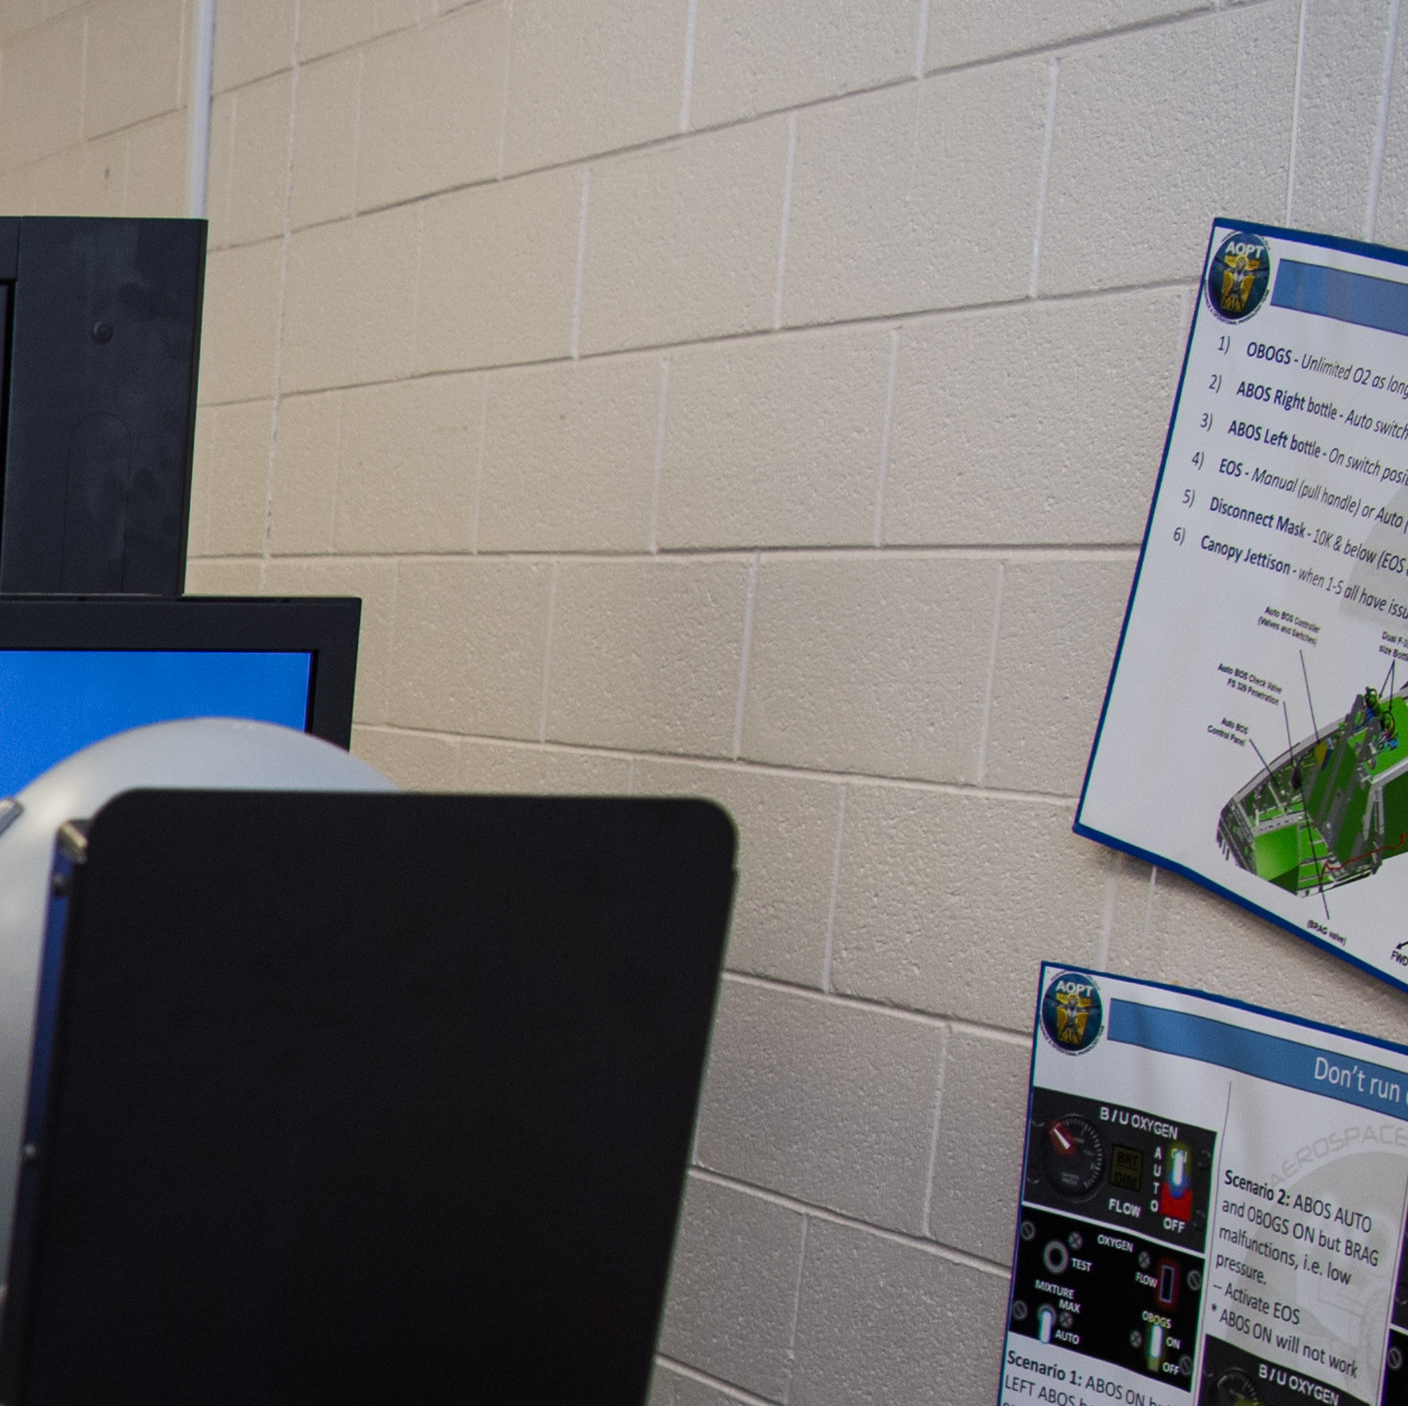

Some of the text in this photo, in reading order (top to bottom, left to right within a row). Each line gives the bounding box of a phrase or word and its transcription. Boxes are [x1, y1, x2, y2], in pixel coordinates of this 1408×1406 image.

[1225, 242, 1264, 259] AOPT
[1217, 336, 1230, 355] 1)
[1247, 342, 1292, 364] OBOGS
[1301, 354, 1353, 380] Unlimited
[1353, 367, 1370, 385] O2
[1372, 375, 1386, 389] as
[1209, 374, 1222, 393] 2)
[1236, 381, 1272, 401] ABOS
[1273, 390, 1307, 411] Right
[1308, 398, 1337, 420] bottle
[1345, 409, 1373, 430] Auto
[1200, 413, 1380, 476] 3) ABOS Left bottle On switch
[1192, 451, 1403, 528] 4) EOS Manual (pull handle) or Auto
[1182, 490, 1405, 574] 5) Disconnect Mask 10K & below (EOS
[1173, 527, 1387, 611] 6) Canopy Jettison when 1-5 all have
[1207, 725, 1246, 746] Control Panel
[1221, 718, 1248, 735] Auto BOS
[1370, 1077, 1400, 1102] run
[1224, 1169, 1372, 1233] Scenario 2: ABOS AUTO
[1097, 1234, 1134, 1252] OXYGEN
[1222, 1200, 1380, 1267] and OBOGS ON but BRAG
[1071, 1258, 1092, 1272] TEST
[1216, 1255, 1266, 1285] pressure.
[1219, 1227, 1352, 1285] malfunctions, i.e. low
[1035, 1280, 1075, 1299] MIXTURE
[1135, 1272, 1158, 1288] FLOW
[1225, 1282, 1301, 1325] Activate EOS
[1005, 1374, 1036, 1396] LEFT
[1007, 1351, 1066, 1381] Scenario
[1069, 1371, 1083, 1386] 1:
[1085, 1376, 1123, 1400] ABOS
